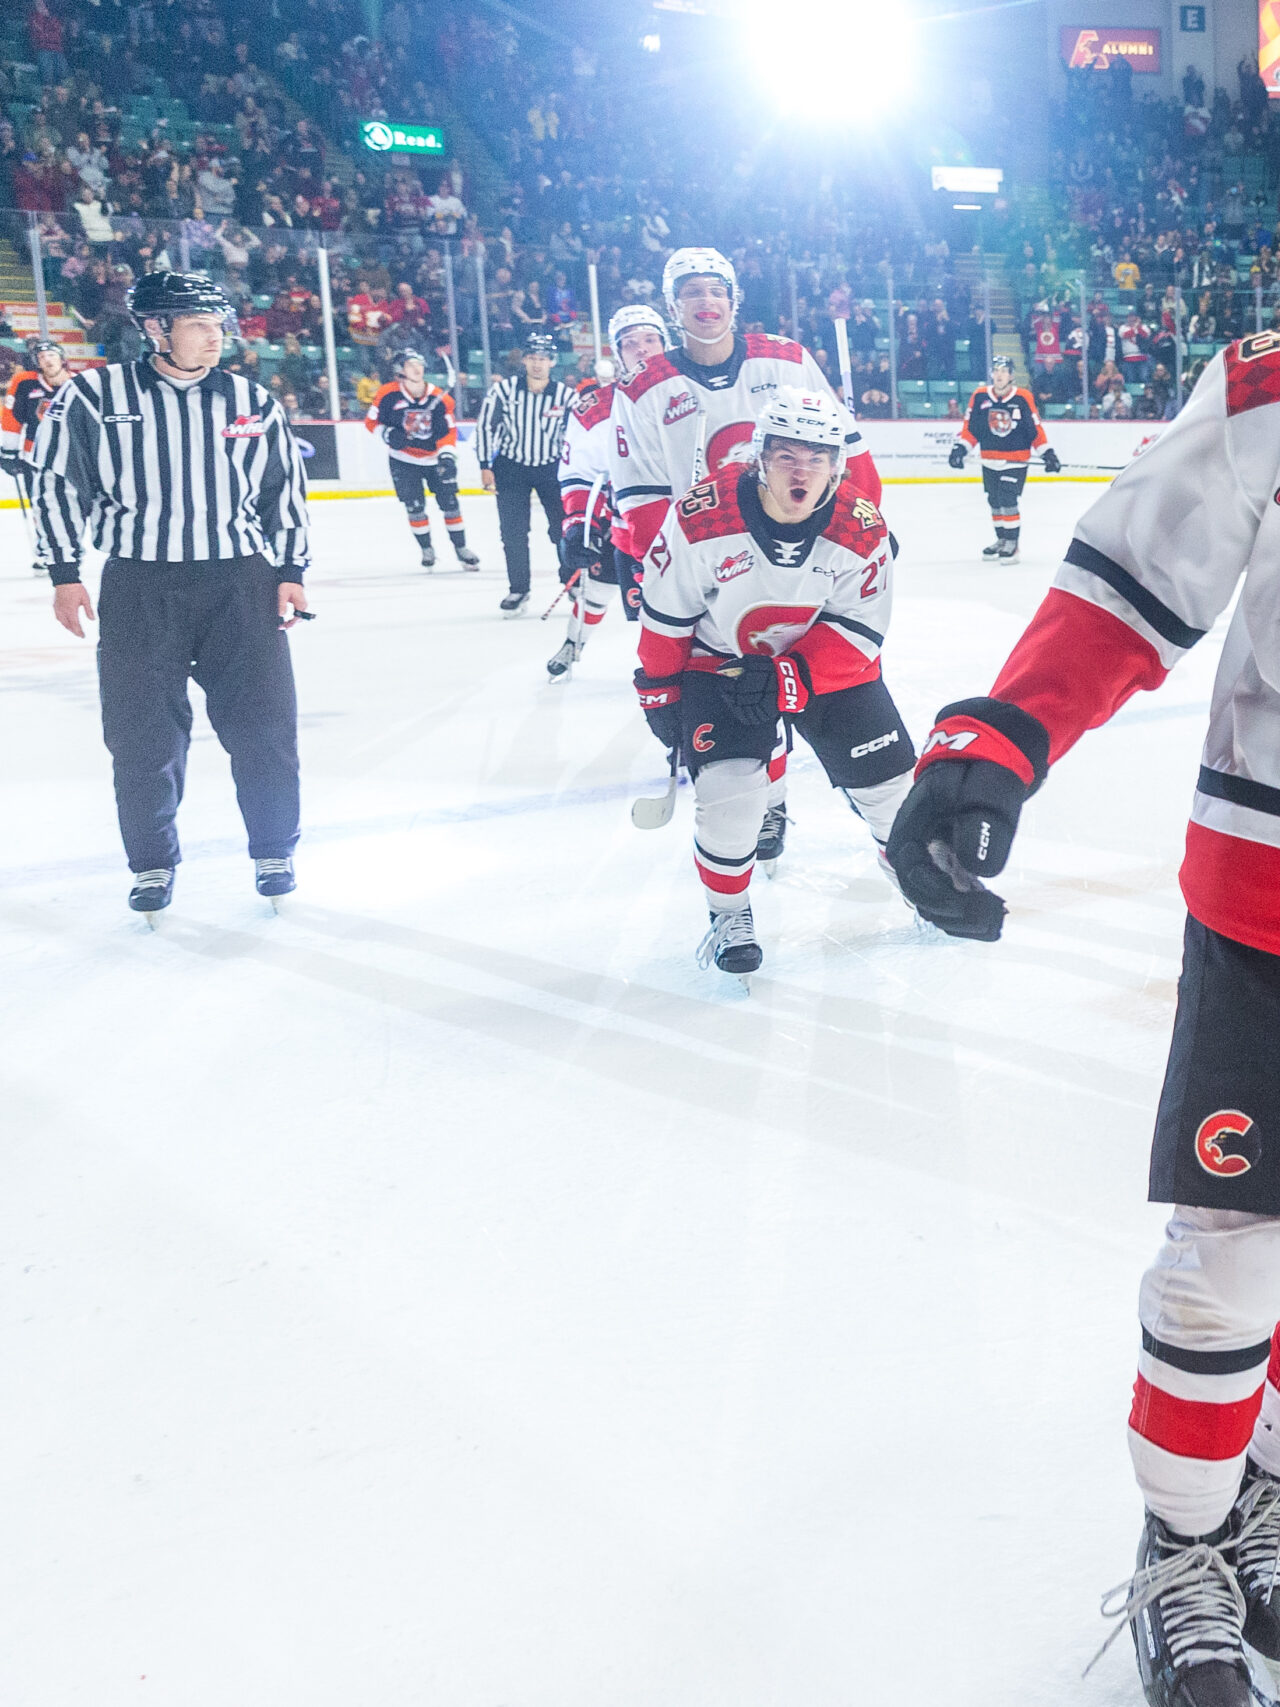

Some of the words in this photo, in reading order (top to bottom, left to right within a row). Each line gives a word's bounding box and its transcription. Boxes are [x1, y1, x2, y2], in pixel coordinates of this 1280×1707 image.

[1103, 44, 1153, 55] ALUMNI
[103, 413, 142, 423] CCM
[664, 396, 698, 420] WHL
[616, 425, 629, 458] 6
[716, 556, 754, 580] WHL
[779, 661, 797, 710] CCM
[850, 729, 899, 759] CCM
[977, 821, 991, 861] CCM
